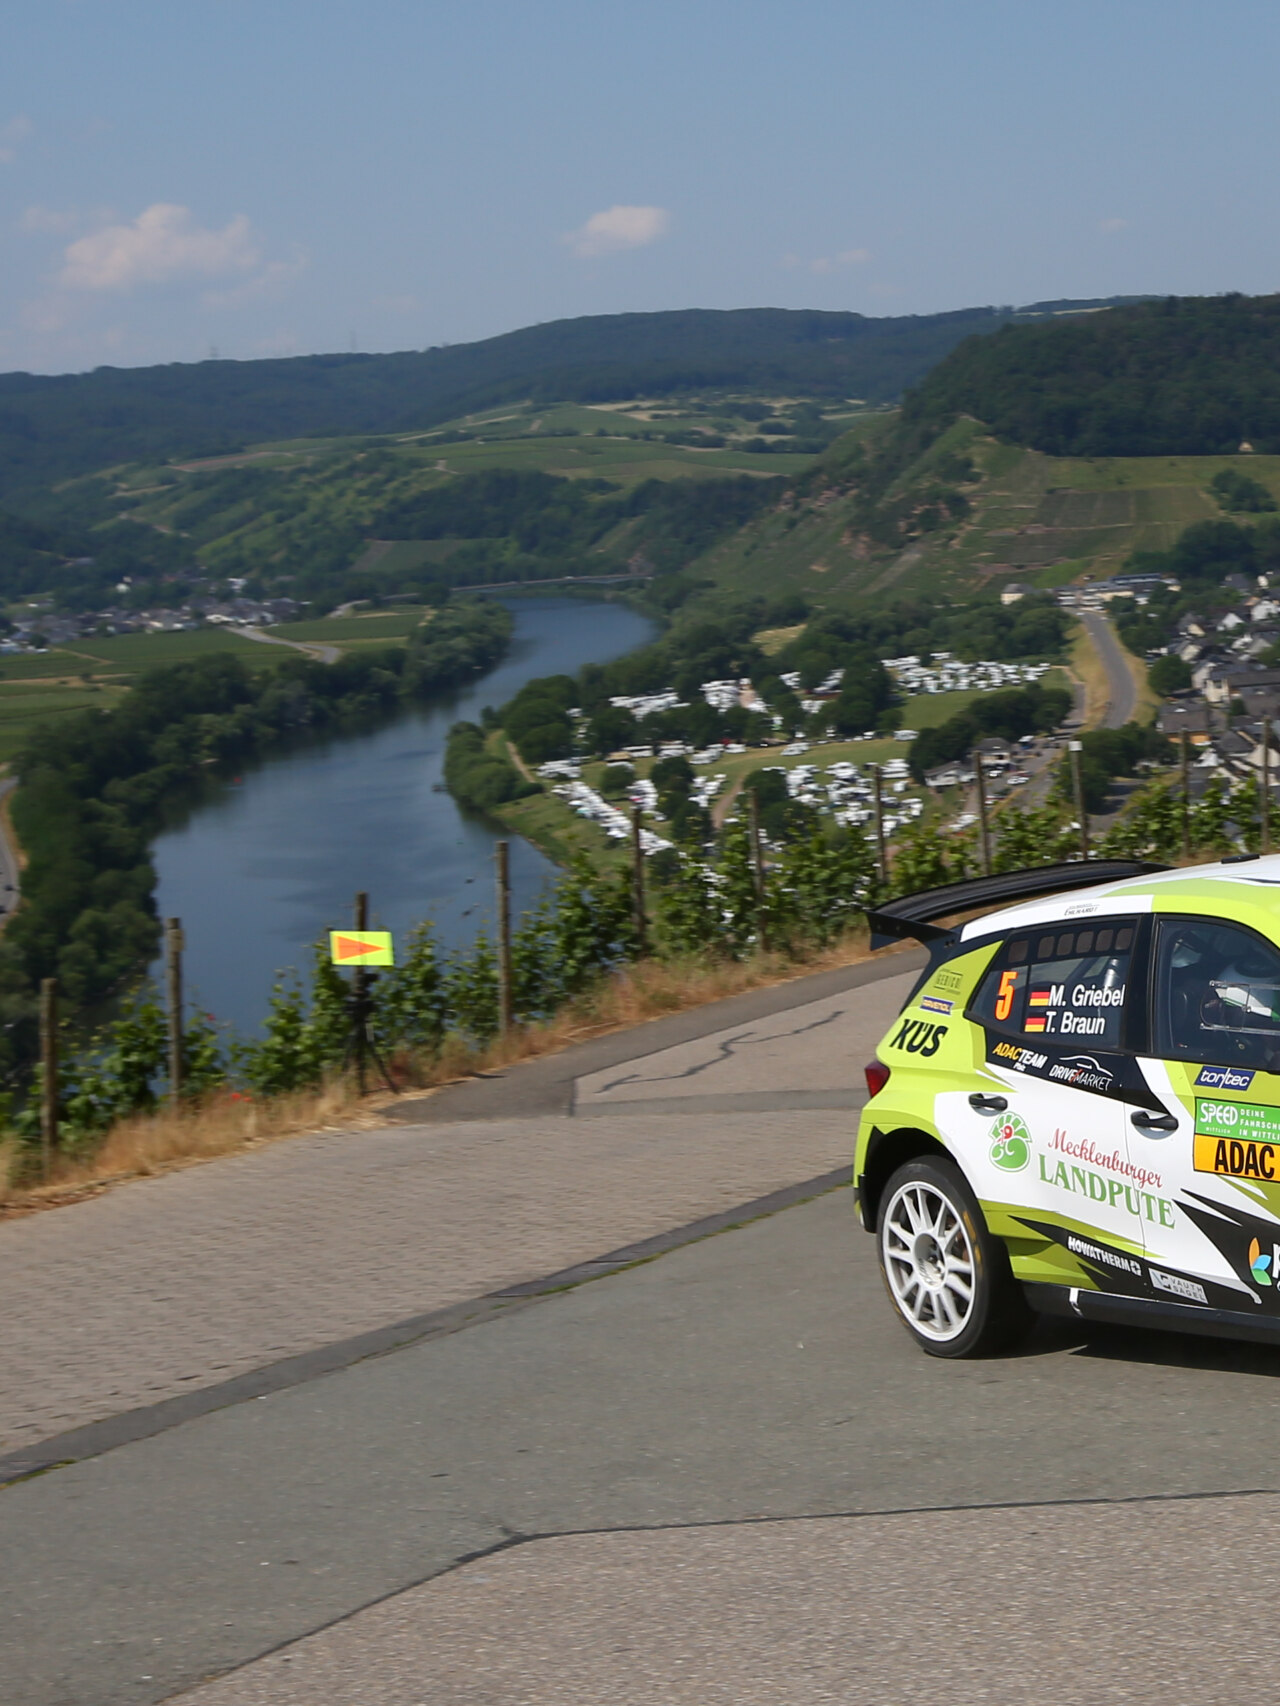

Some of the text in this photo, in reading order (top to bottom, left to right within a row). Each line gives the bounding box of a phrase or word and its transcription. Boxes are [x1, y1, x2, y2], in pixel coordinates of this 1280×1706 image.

[995, 970, 1018, 1020] 5
[1048, 983, 1126, 1007] M. Griebel
[889, 1018, 949, 1057] KÜS
[1045, 1010, 1106, 1035] T. Braun
[1200, 1102, 1238, 1126] SPEED
[1240, 1108, 1265, 1119] DEINE
[1239, 1129, 1248, 1137] IN
[1047, 1128, 1163, 1189] Mecklenburger
[1214, 1139, 1275, 1179] ADAC
[1038, 1153, 1176, 1230] LANDPUTE
[1067, 1236, 1131, 1272] HOWATHERM
[1170, 1277, 1203, 1294] VAUTH
